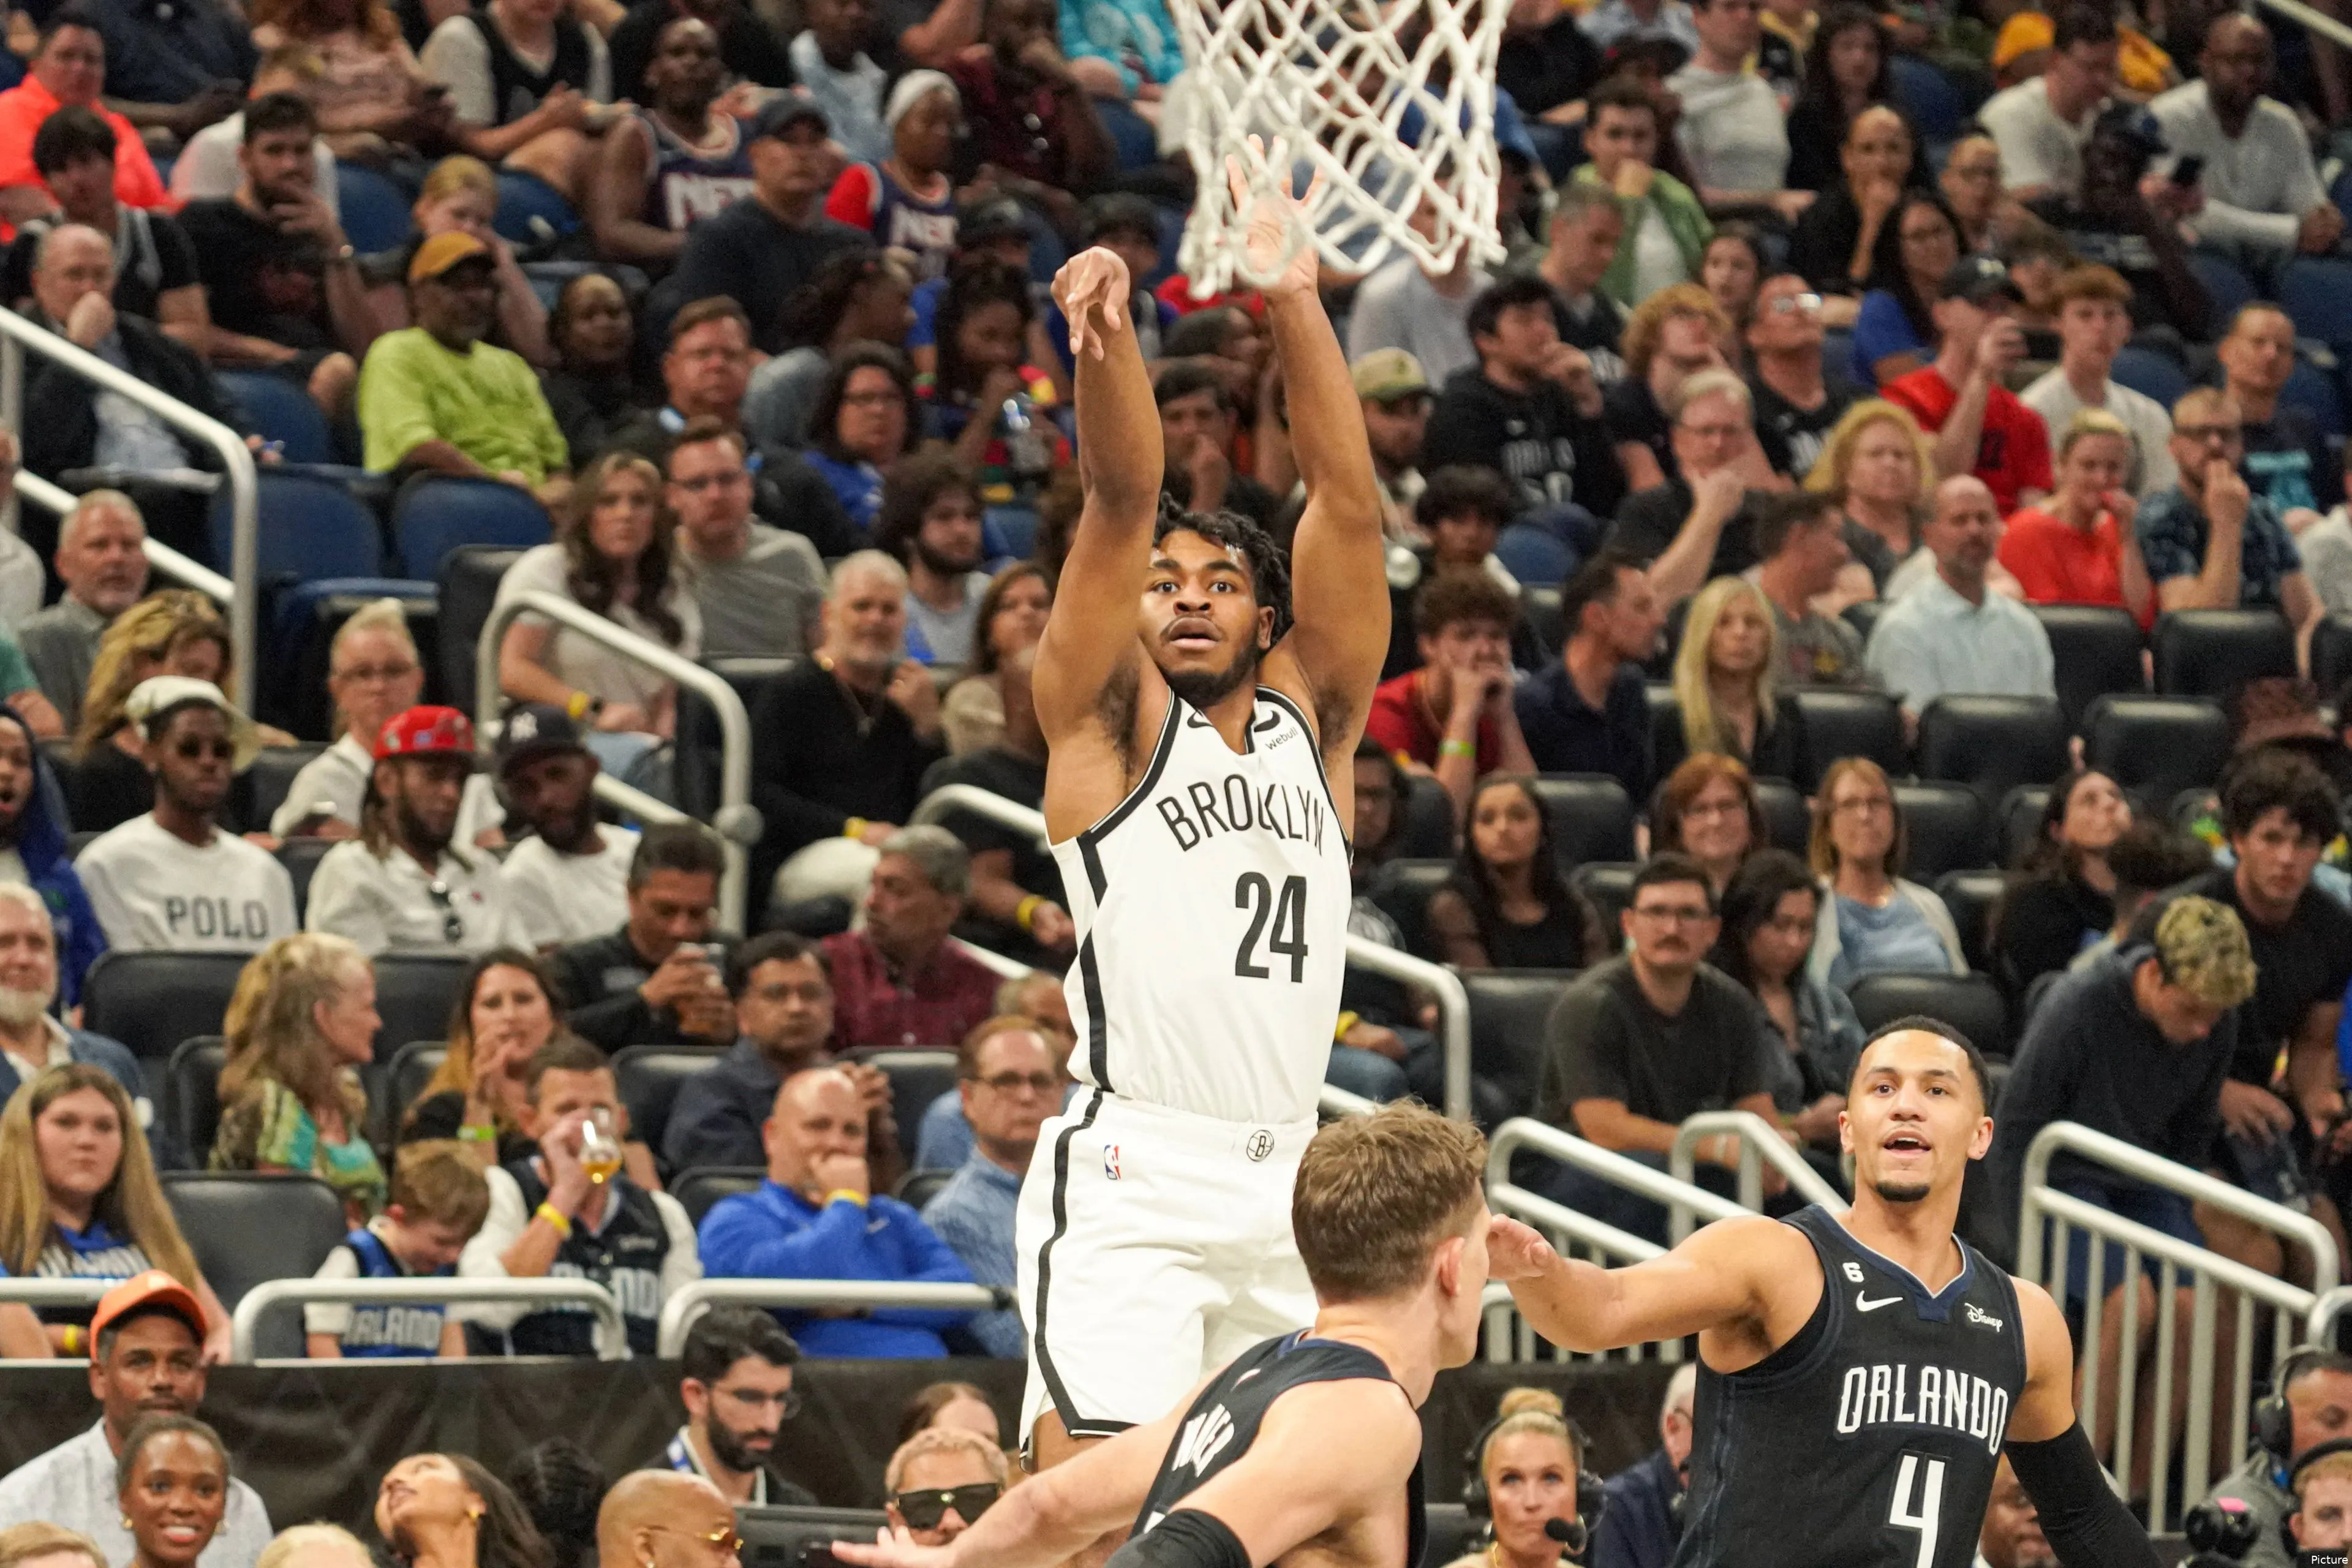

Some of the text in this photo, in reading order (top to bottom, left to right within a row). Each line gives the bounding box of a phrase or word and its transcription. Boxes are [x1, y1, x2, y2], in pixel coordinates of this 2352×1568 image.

[165, 895, 269, 940] POLO
[1235, 871, 1308, 983] 24
[1842, 1262, 1864, 1283] 6
[1837, 1363, 2009, 1450] ORLANDO
[1889, 1455, 1946, 1568] 4
